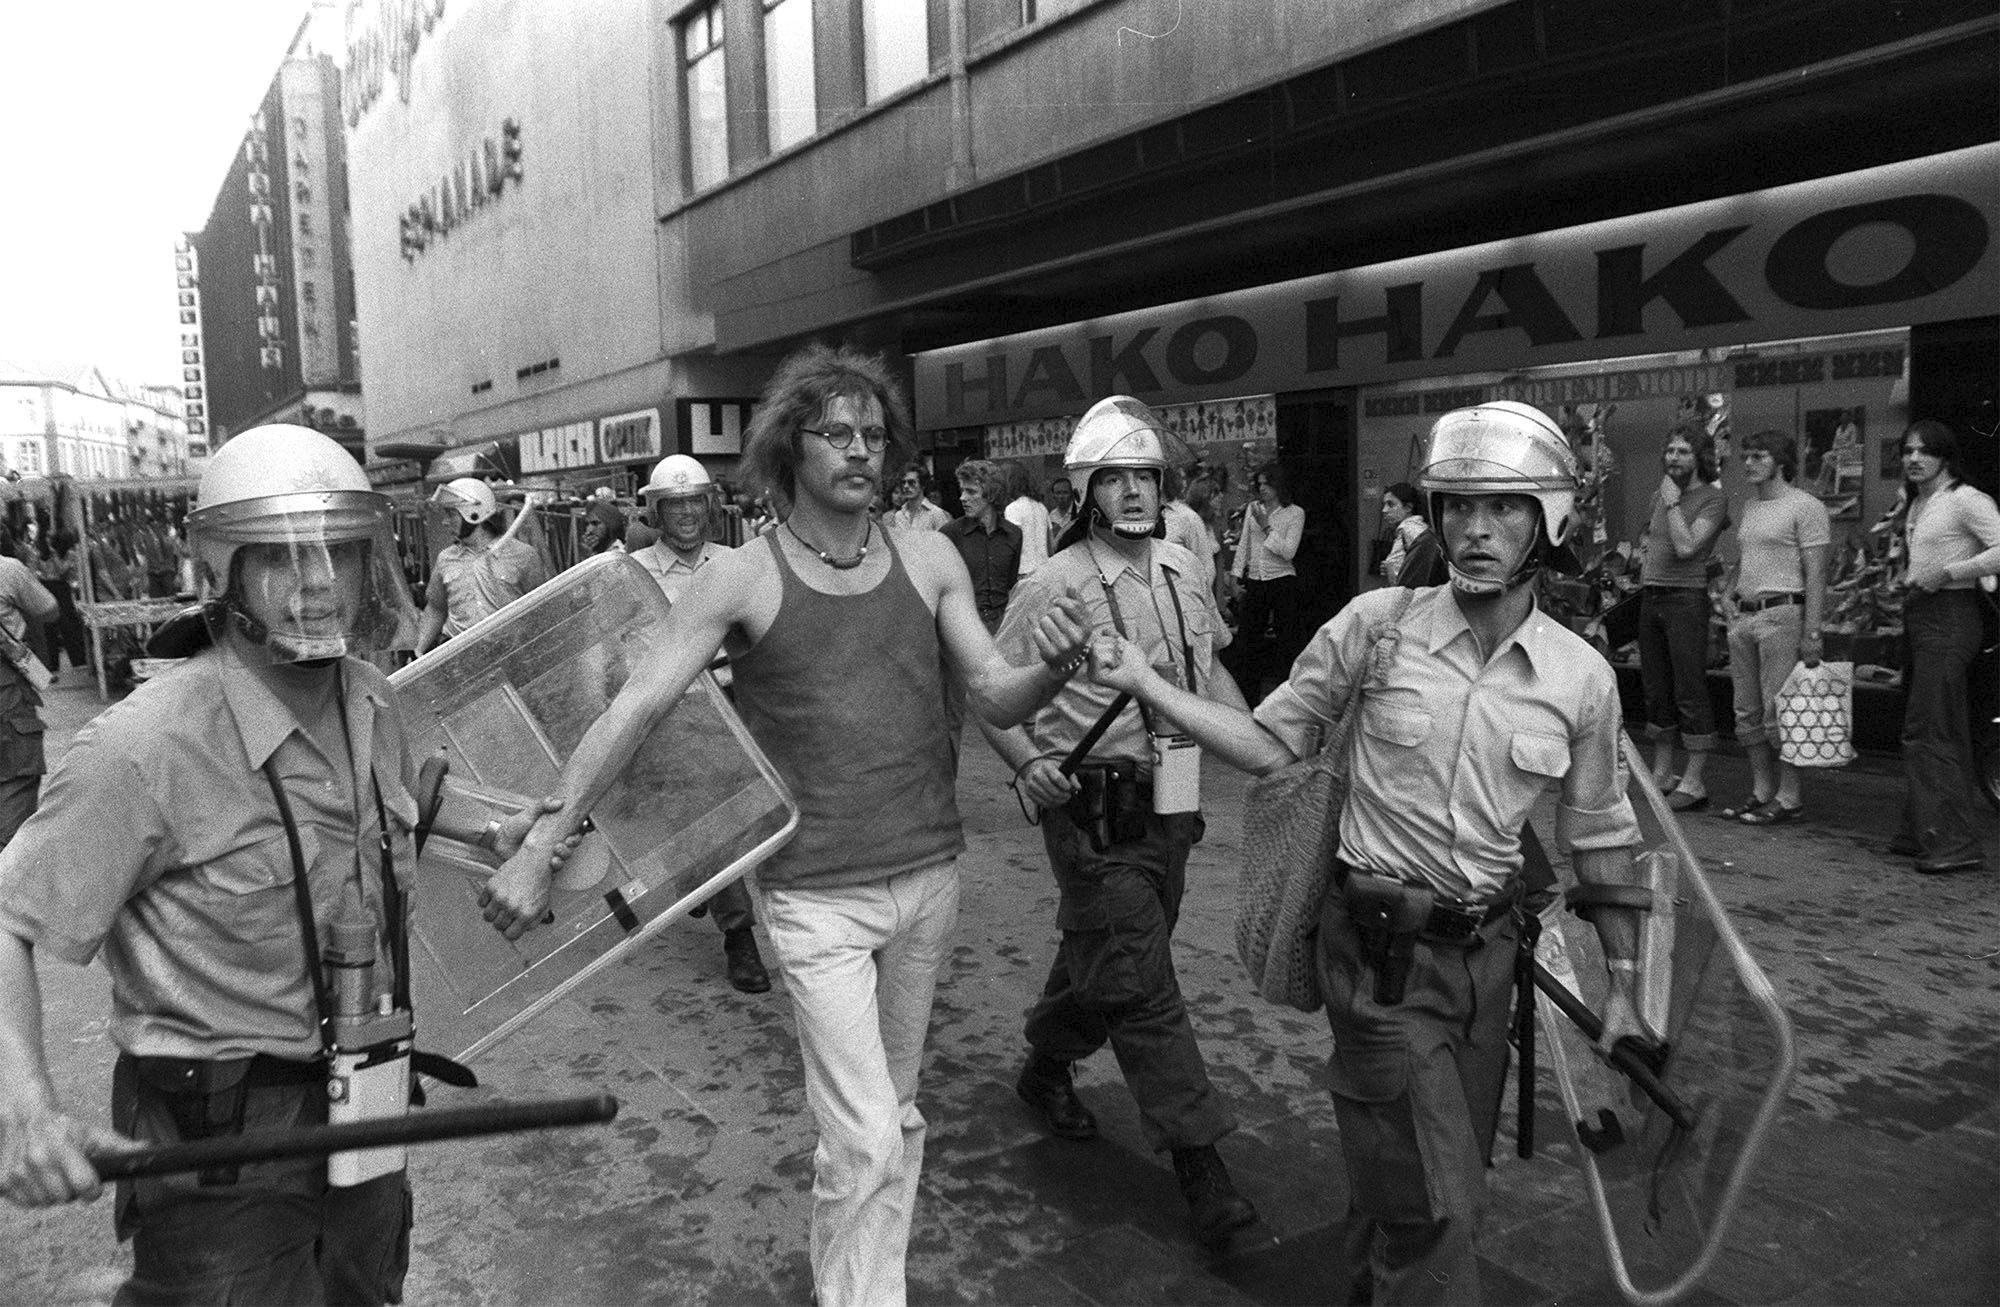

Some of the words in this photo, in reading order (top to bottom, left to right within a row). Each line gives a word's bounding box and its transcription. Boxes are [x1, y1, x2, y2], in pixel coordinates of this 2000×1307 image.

[1304, 193, 1988, 373] HAKO
[945, 315, 1258, 413] HAKO
[690, 403, 741, 454] U
